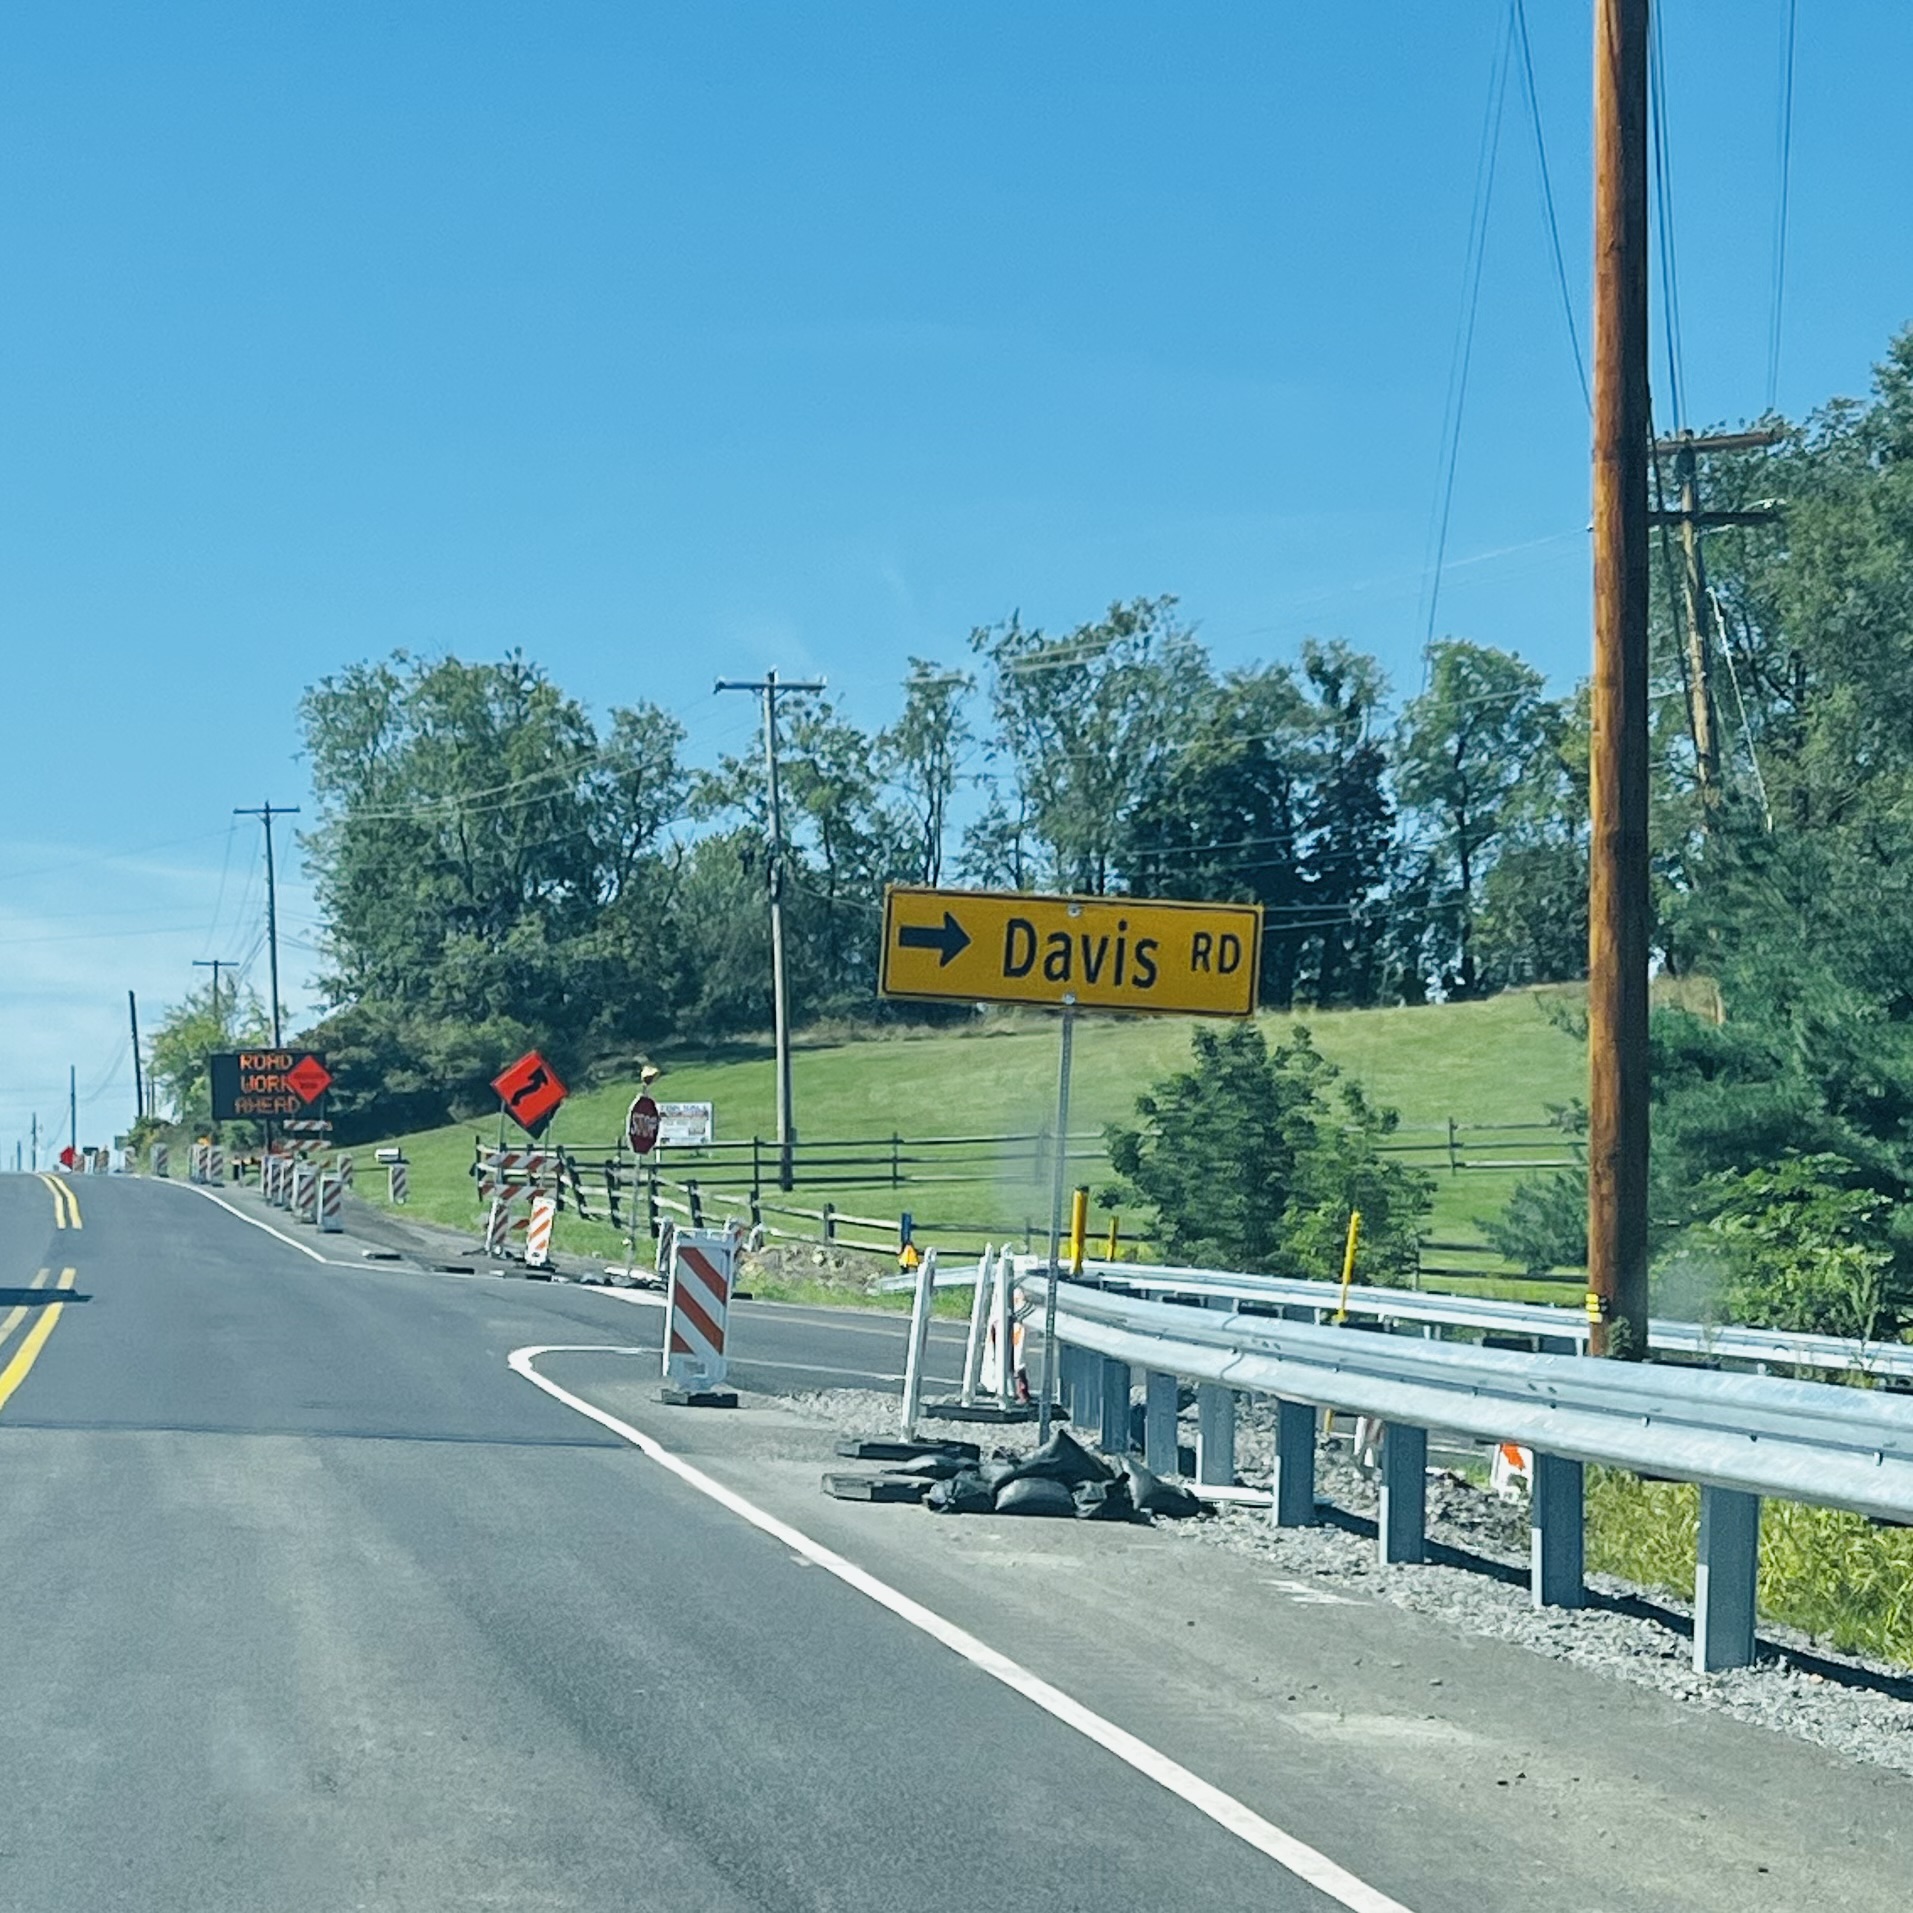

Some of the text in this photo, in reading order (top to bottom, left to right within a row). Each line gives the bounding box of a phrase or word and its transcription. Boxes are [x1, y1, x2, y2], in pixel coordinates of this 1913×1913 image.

[1003, 917, 1242, 989] Davis RD
[240, 1054, 293, 1070] ROAD
[234, 1096, 301, 1114] AHEAD
[631, 1112, 658, 1138] STOP
